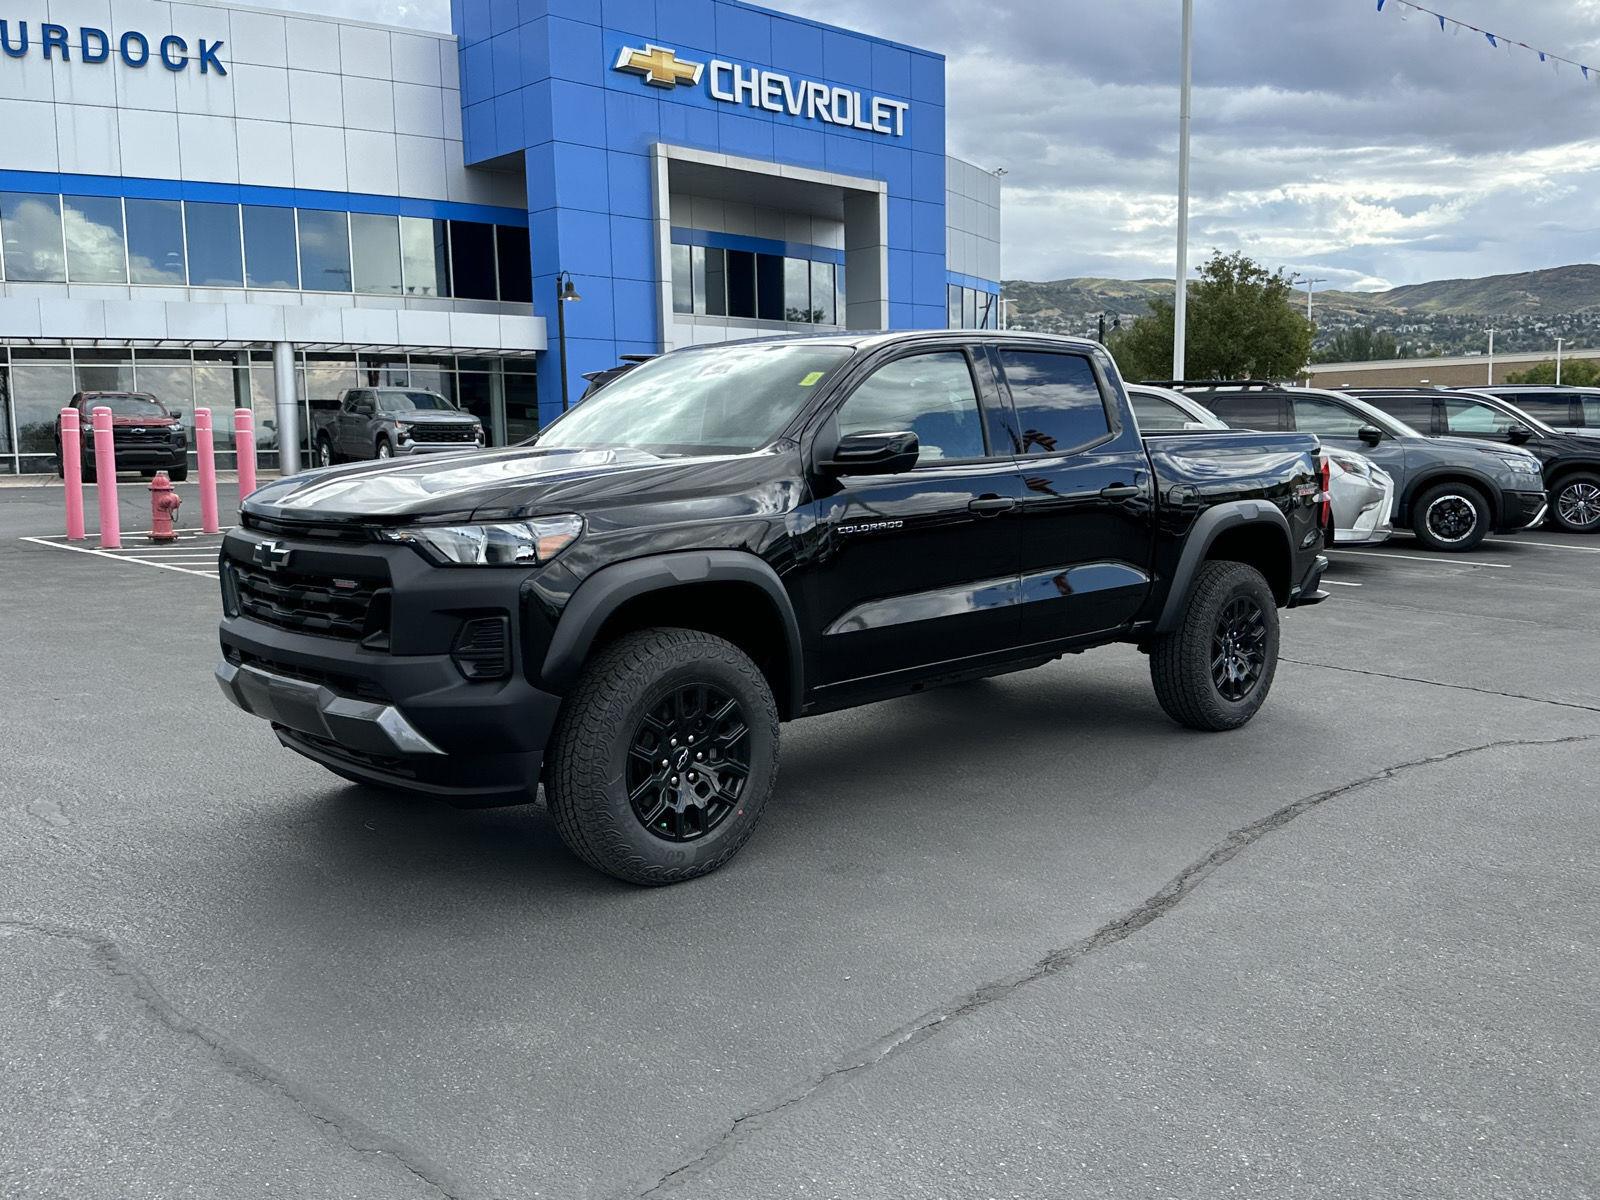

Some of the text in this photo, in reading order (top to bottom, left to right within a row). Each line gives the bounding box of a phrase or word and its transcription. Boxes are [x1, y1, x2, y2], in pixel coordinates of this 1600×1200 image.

[0, 19, 228, 76] URDOCK
[709, 59, 909, 136] CHEVROLET
[837, 520, 904, 534] COLORADO
